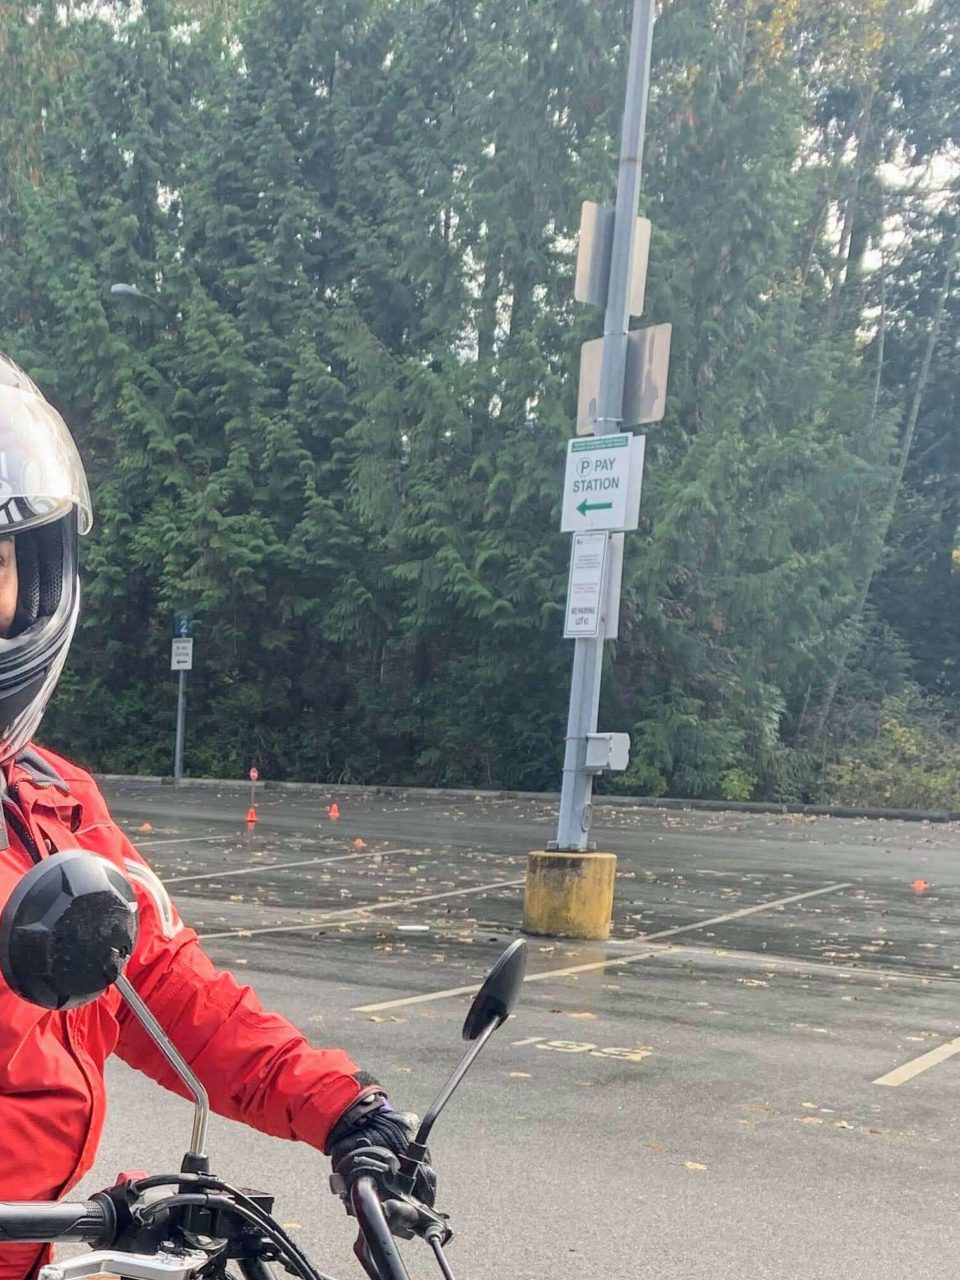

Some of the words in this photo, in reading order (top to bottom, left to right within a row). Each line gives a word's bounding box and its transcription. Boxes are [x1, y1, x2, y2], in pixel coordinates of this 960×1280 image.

[580, 461, 590, 475] P
[594, 458, 616, 472] PAY
[573, 476, 619, 493] STATION
